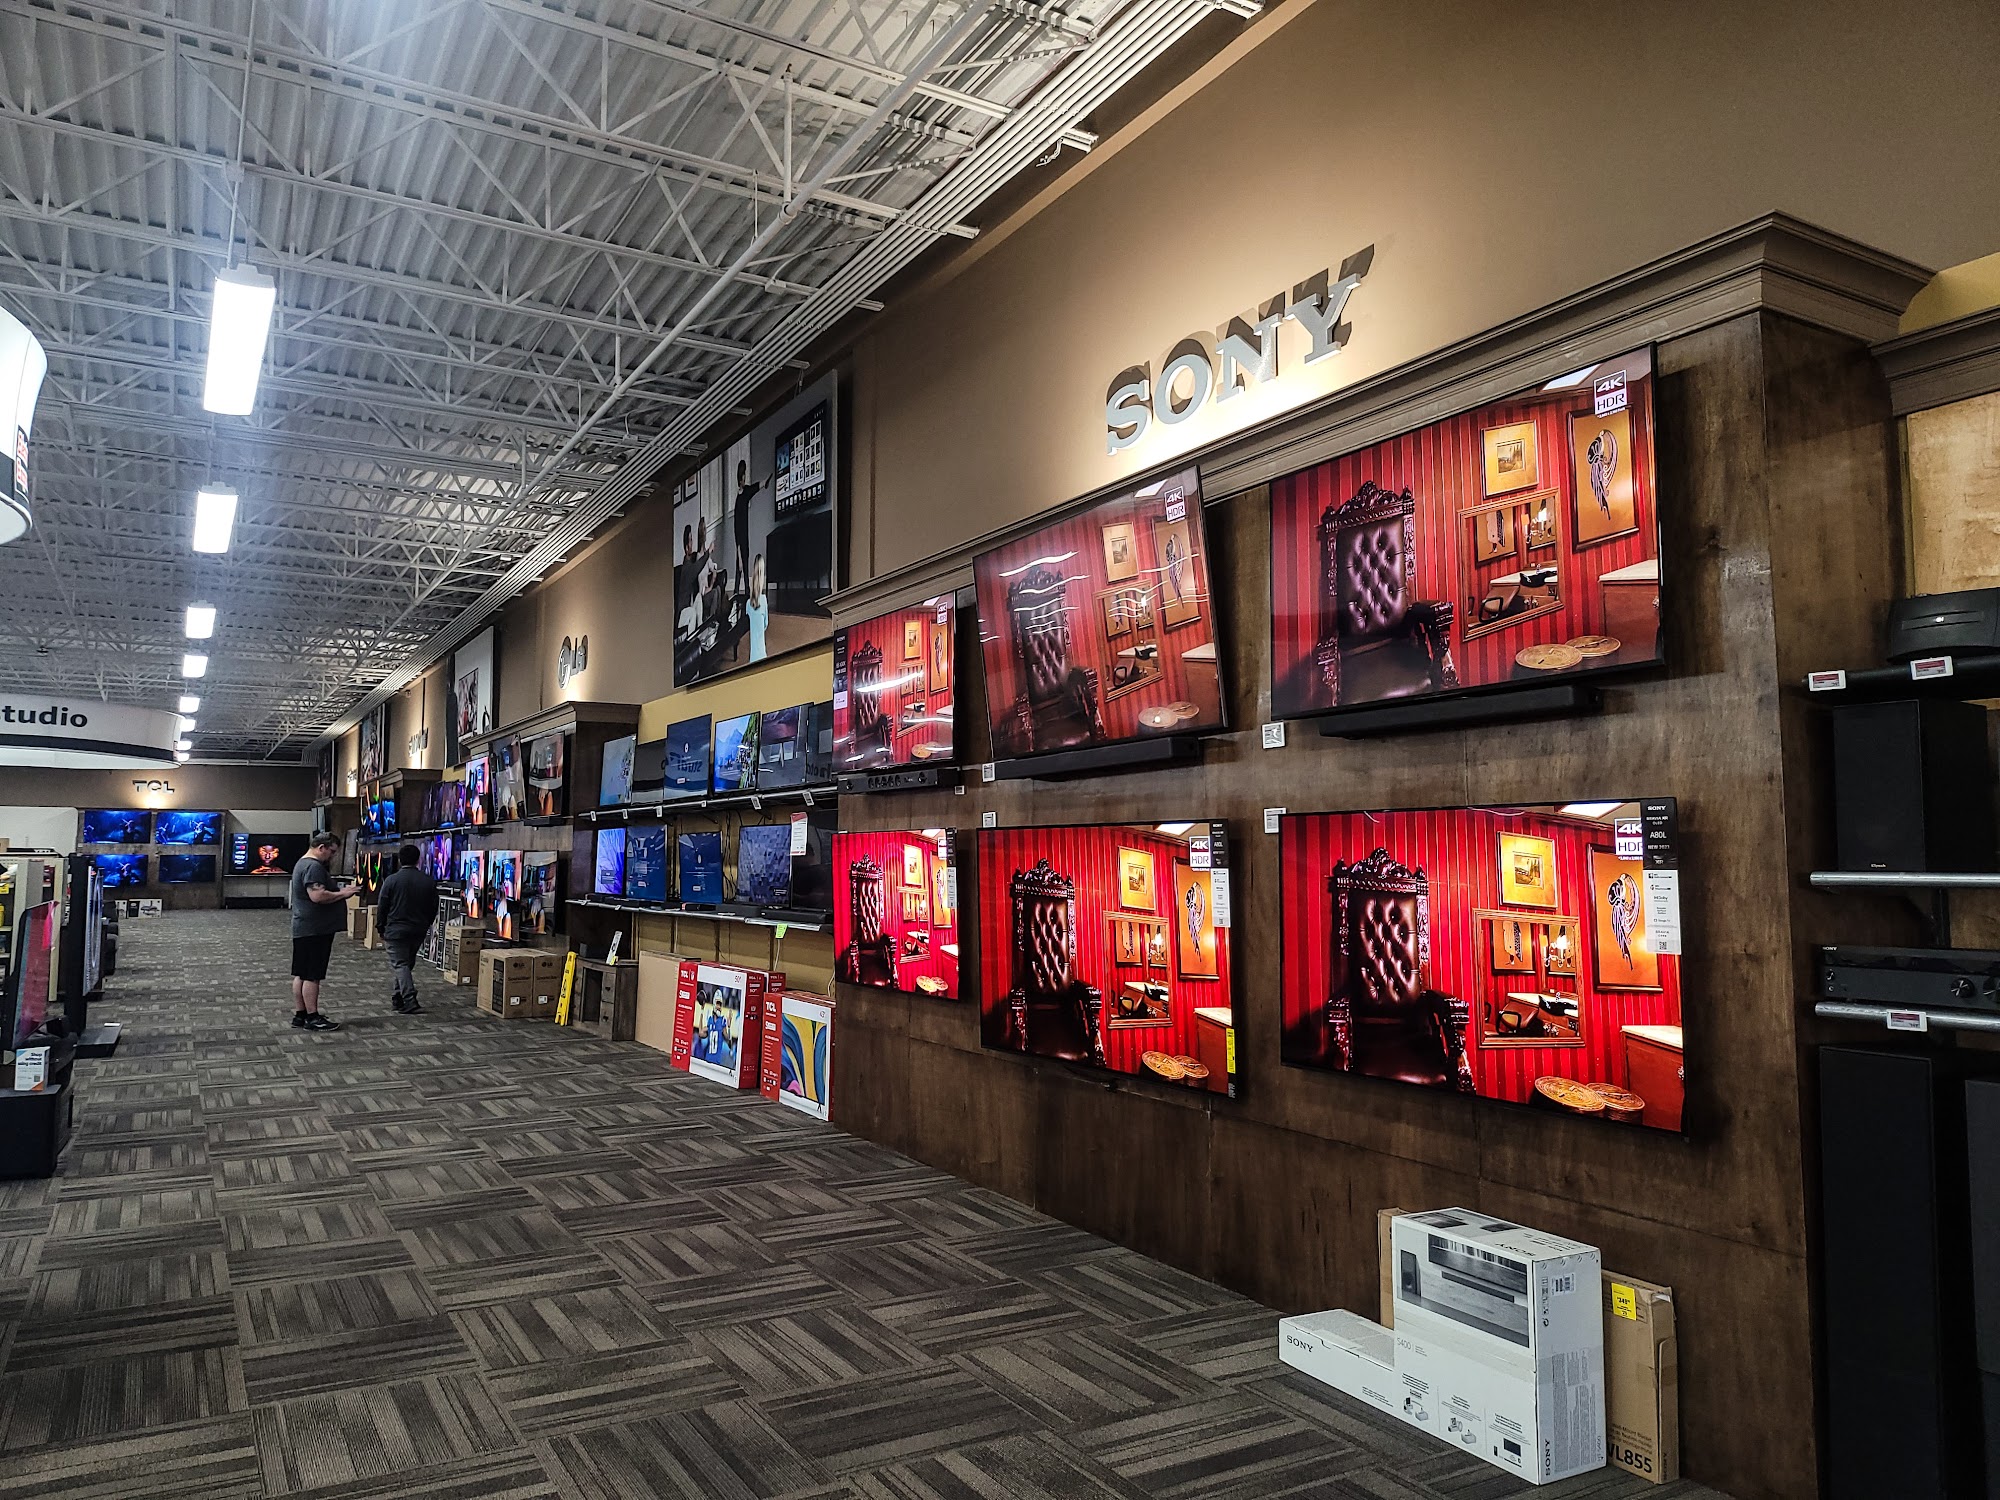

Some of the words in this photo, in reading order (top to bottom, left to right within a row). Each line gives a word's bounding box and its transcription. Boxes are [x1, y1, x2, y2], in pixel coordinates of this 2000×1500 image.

[1105, 272, 1362, 456] SONY
[1597, 376, 1624, 393] 4K
[1597, 393, 1625, 411] HDR
[1167, 491, 1182, 503] 4K
[1168, 505, 1184, 519] HDR
[0, 705, 88, 728] tudio
[133, 780, 175, 795] TCL
[1617, 823, 1642, 835] 4K
[1649, 831, 1667, 839] A80L
[1191, 840, 1209, 850] 4K
[1191, 855, 1209, 865] HDR
[765, 1001, 777, 1013] TCL
[1286, 1334, 1314, 1353] SONY
[1396, 1337, 1412, 1350] S400
